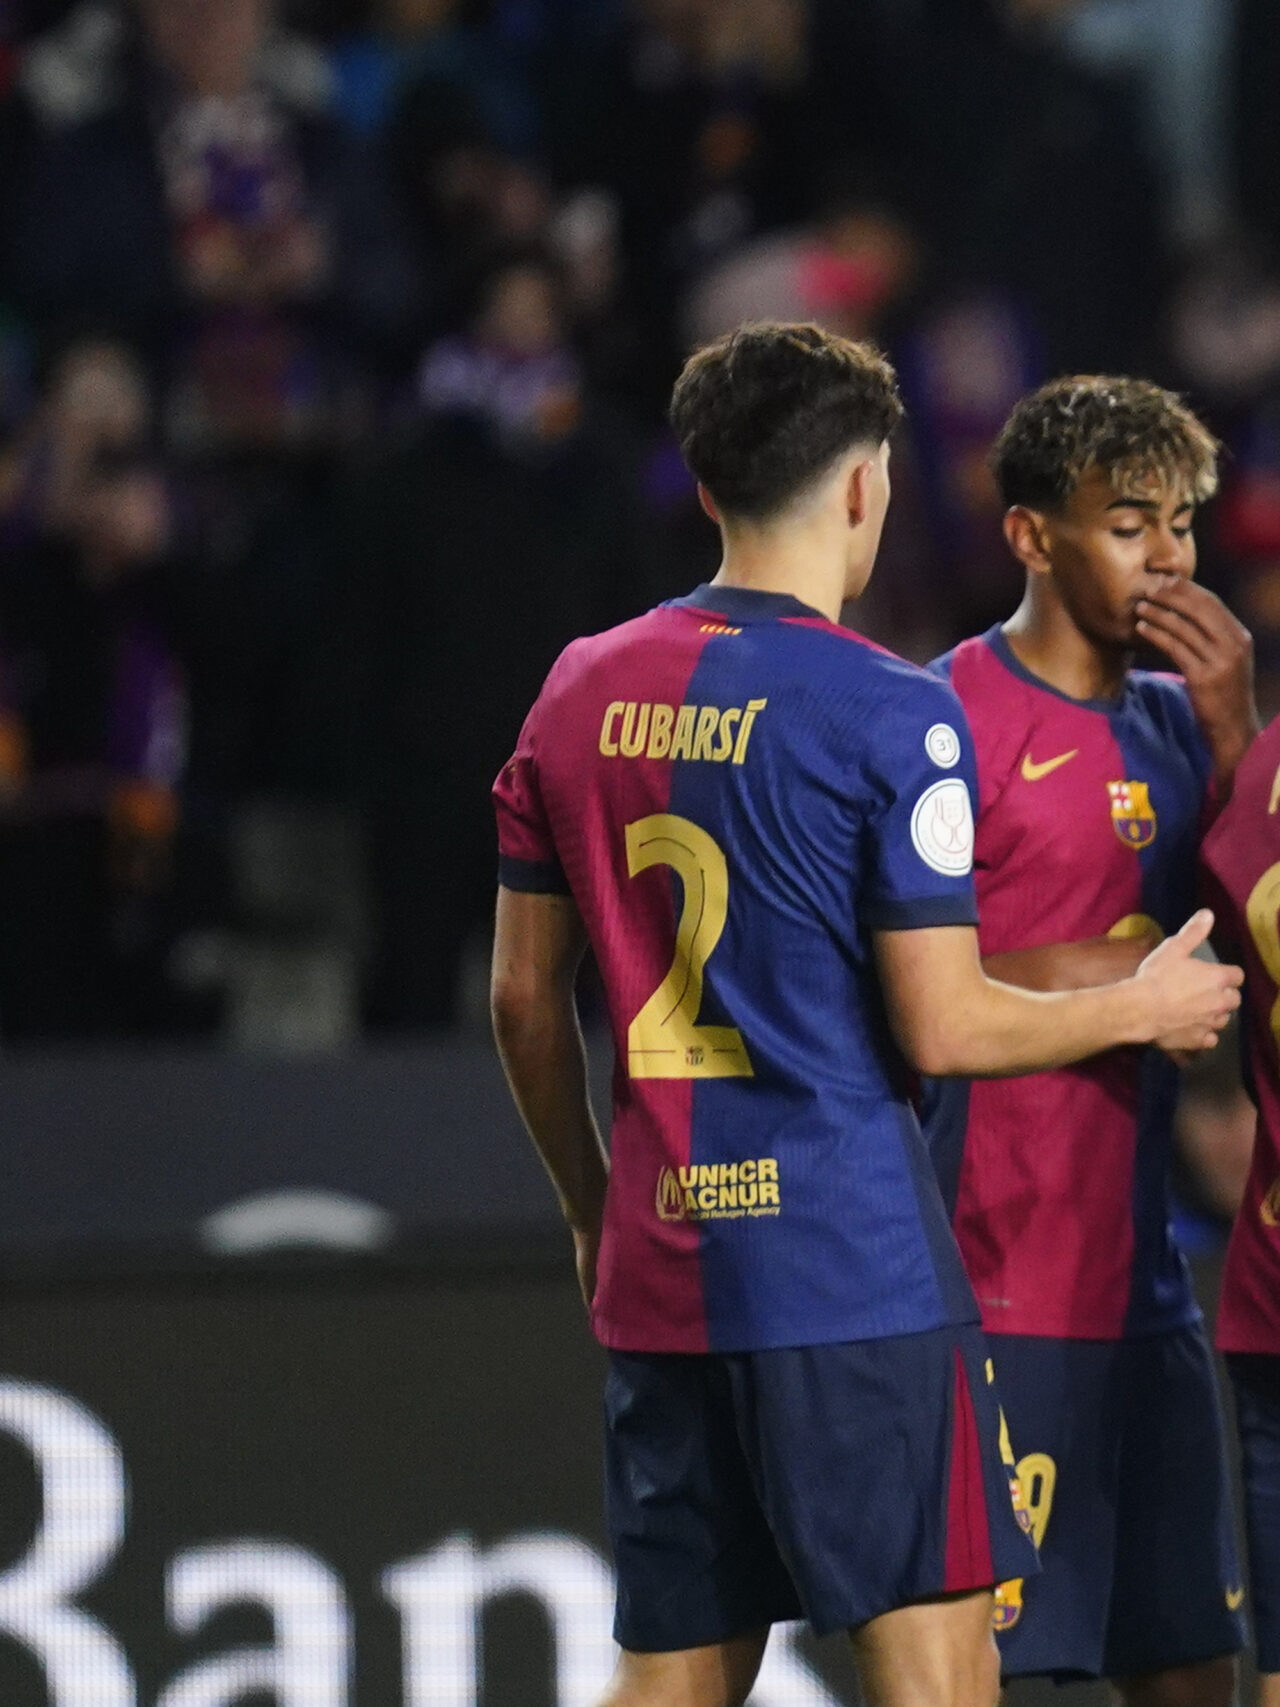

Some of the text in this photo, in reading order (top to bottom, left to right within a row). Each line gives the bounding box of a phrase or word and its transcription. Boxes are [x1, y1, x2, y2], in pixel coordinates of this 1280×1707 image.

[599, 698, 768, 764] CUBARSÍ
[625, 813, 754, 1079] 2
[678, 1158, 779, 1188] UNHCR
[684, 1182, 780, 1210] ACNUR
